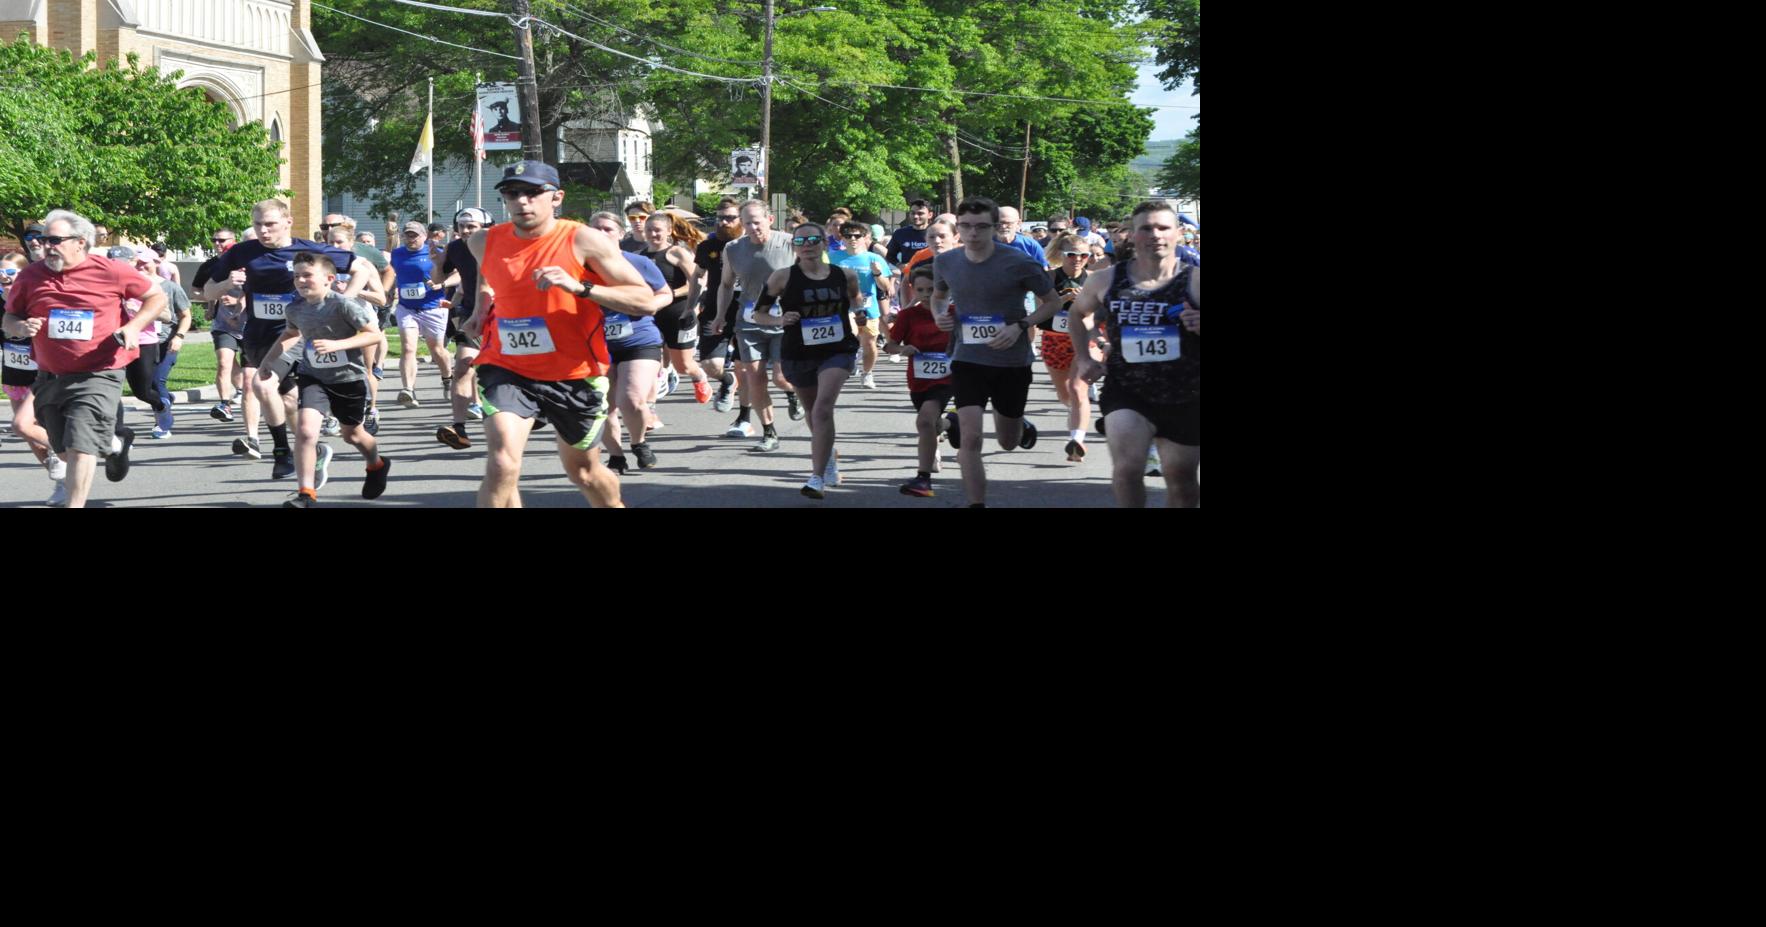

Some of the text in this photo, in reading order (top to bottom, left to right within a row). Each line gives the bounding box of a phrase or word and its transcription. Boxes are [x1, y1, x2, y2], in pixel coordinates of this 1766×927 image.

[803, 287, 841, 303] RUN
[263, 303, 283, 315] 183
[1110, 300, 1169, 313] FLEET
[1118, 313, 1164, 325] FEET
[58, 320, 82, 333] 344
[604, 323, 622, 336] 227
[811, 325, 835, 340] 224
[971, 325, 996, 339] 209
[508, 331, 540, 349] 342
[1136, 339, 1167, 356] 143
[10, 352, 30, 366] 343
[315, 351, 337, 364] 226
[923, 361, 947, 374] 225
